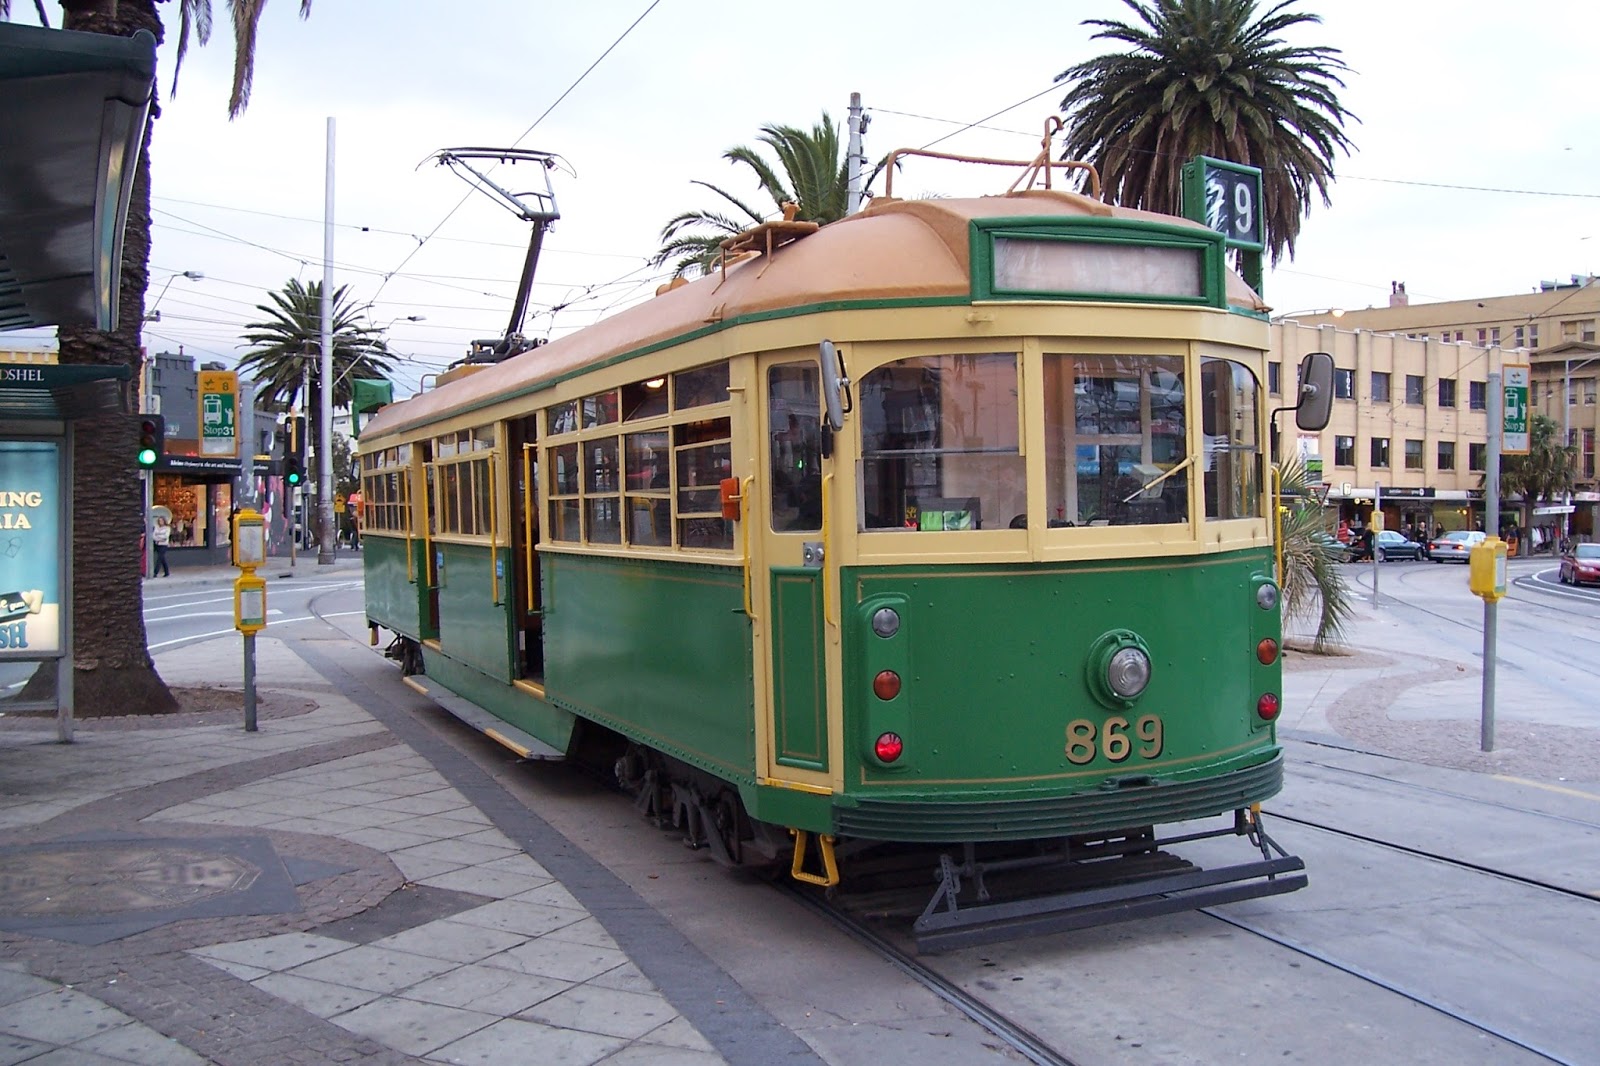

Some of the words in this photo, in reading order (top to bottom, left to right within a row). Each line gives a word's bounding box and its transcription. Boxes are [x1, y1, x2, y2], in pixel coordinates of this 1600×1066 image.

[0, 368, 45, 381] DSHEL
[222, 381, 229, 391] 8
[204, 425, 223, 437] Stop
[223, 426, 235, 436] 31
[1503, 420, 1518, 432] Stop
[0, 513, 32, 529] IA
[9, 601, 26, 611] gum
[1064, 714, 1163, 764] 869
